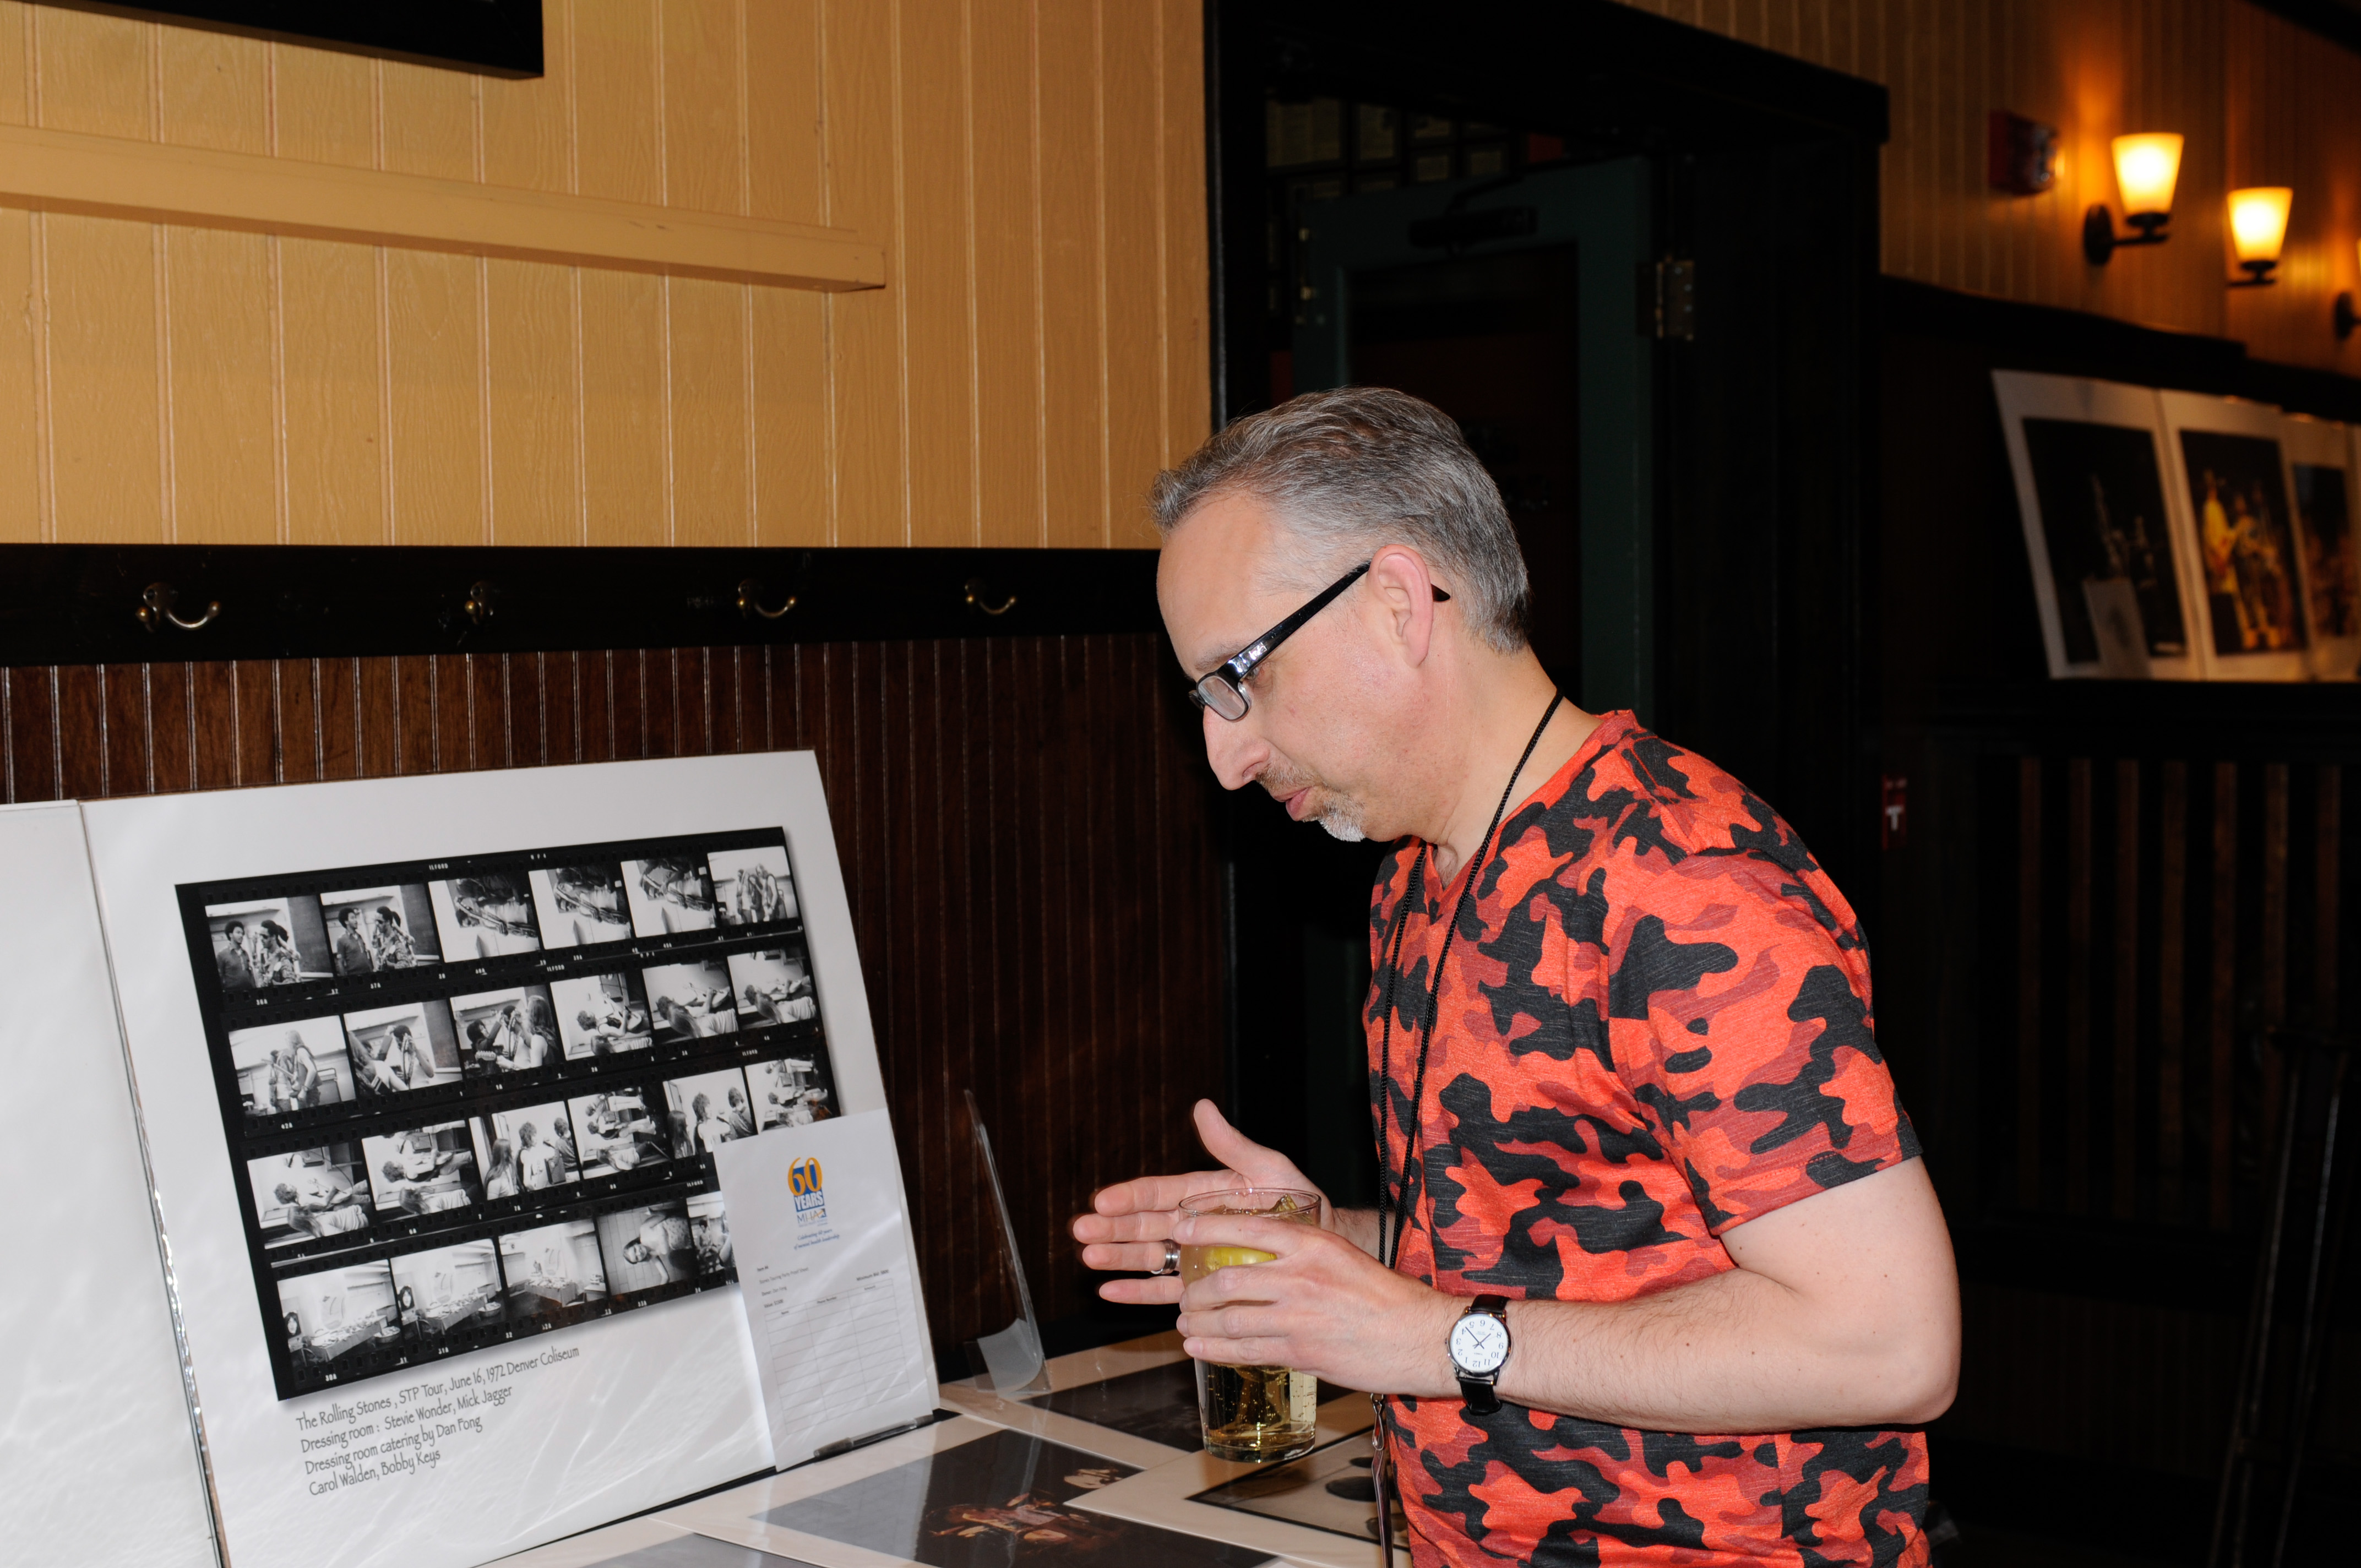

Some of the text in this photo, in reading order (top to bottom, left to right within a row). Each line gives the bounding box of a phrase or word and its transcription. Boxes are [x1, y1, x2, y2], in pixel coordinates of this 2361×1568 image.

[787, 1157, 823, 1196] 60
[795, 1191, 824, 1211] YEARS
[797, 1210, 820, 1223] MHA
[296, 1411, 318, 1431] The
[319, 1403, 356, 1424] Rolling
[356, 1398, 391, 1415] Stones
[399, 1387, 419, 1404] STP
[421, 1384, 447, 1397] Tour,
[449, 1377, 472, 1391] June
[472, 1368, 485, 1385] 16,
[486, 1365, 505, 1382] 1972
[507, 1358, 538, 1375] Denver
[540, 1346, 579, 1365] Coliseum
[301, 1430, 349, 1453] Dressing
[349, 1424, 374, 1440] room
[384, 1411, 415, 1430] Stevie
[416, 1397, 456, 1420] Wonder,
[456, 1389, 480, 1410] Mick
[482, 1386, 512, 1406] Jagger
[305, 1416, 483, 1474] Dressing room catering by Dan Fong
[309, 1450, 440, 1495] Carol Walden, Bobby Keys
